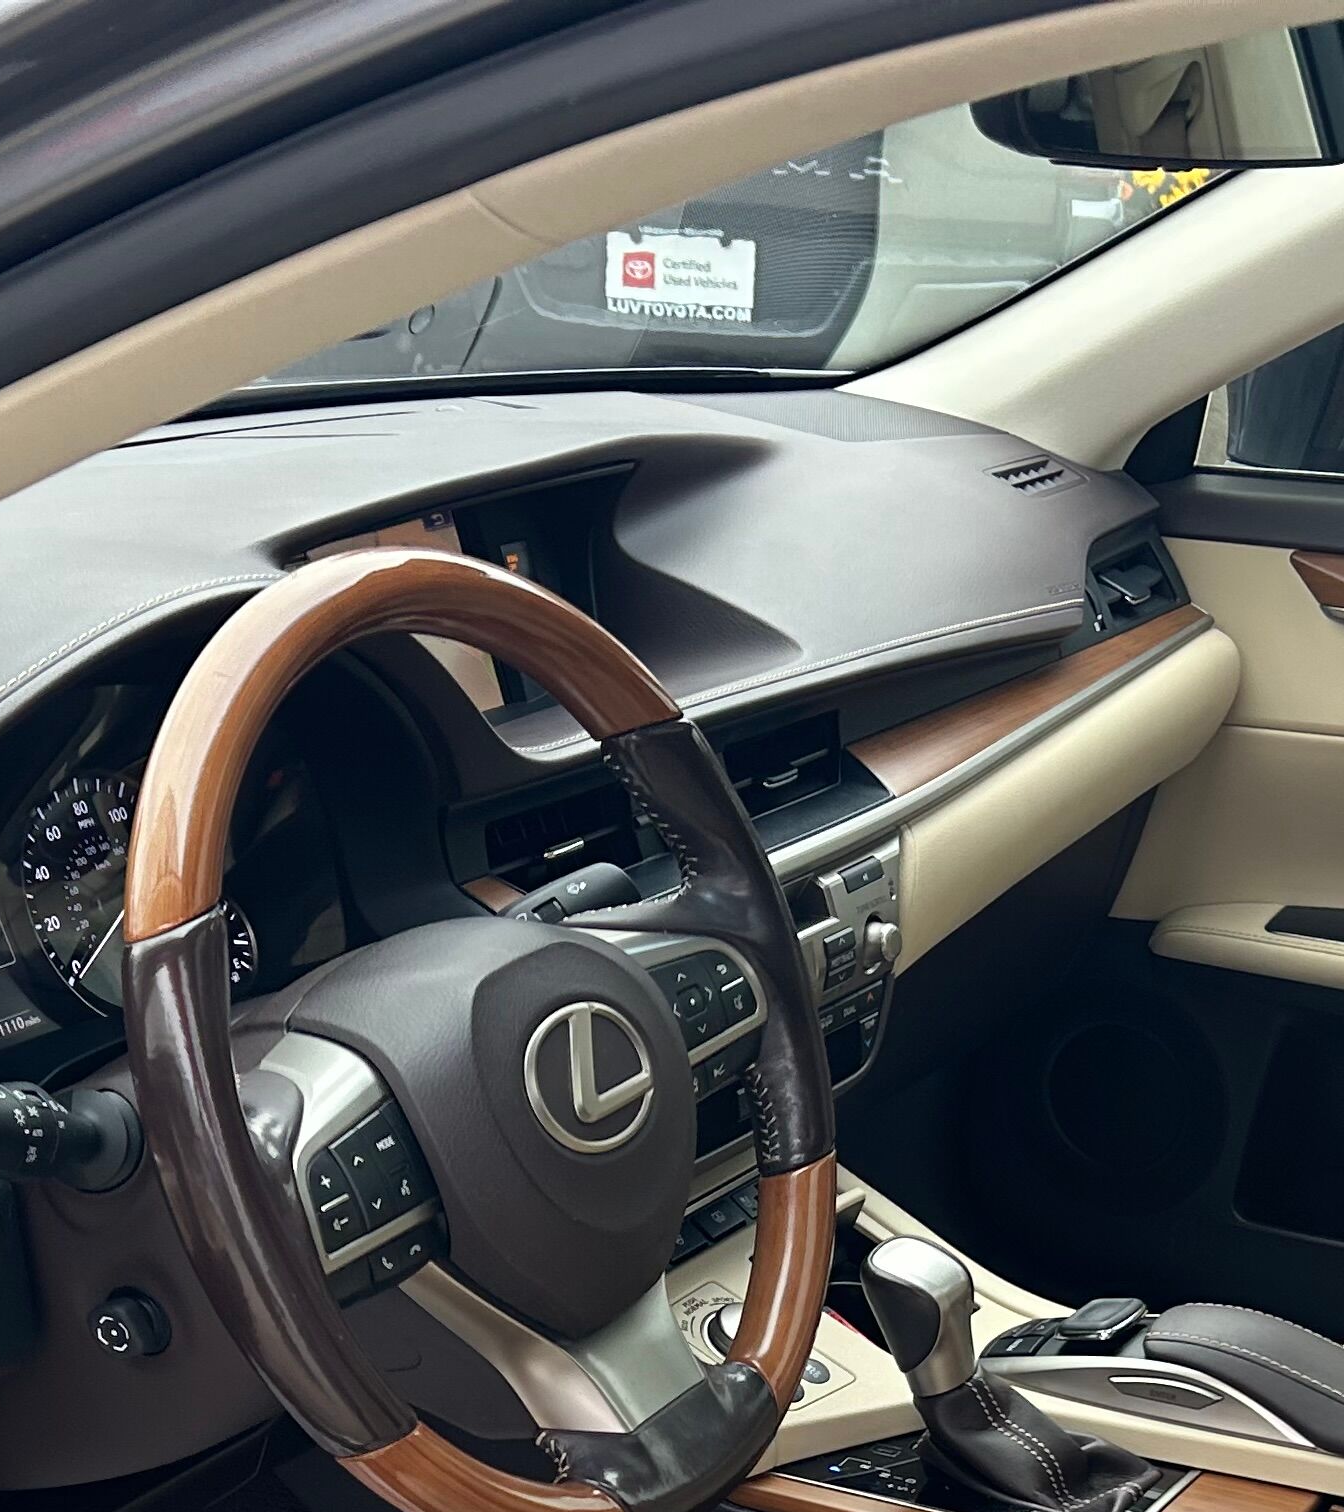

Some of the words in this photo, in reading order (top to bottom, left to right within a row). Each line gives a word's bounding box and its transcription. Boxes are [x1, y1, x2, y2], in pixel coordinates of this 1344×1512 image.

[606, 297, 752, 324] LUVTOYOTA.COM
[72, 800, 88, 816] 80
[108, 806, 128, 824] 100
[45, 825, 61, 842] 60
[35, 865, 50, 881] 40
[43, 915, 61, 932] 20
